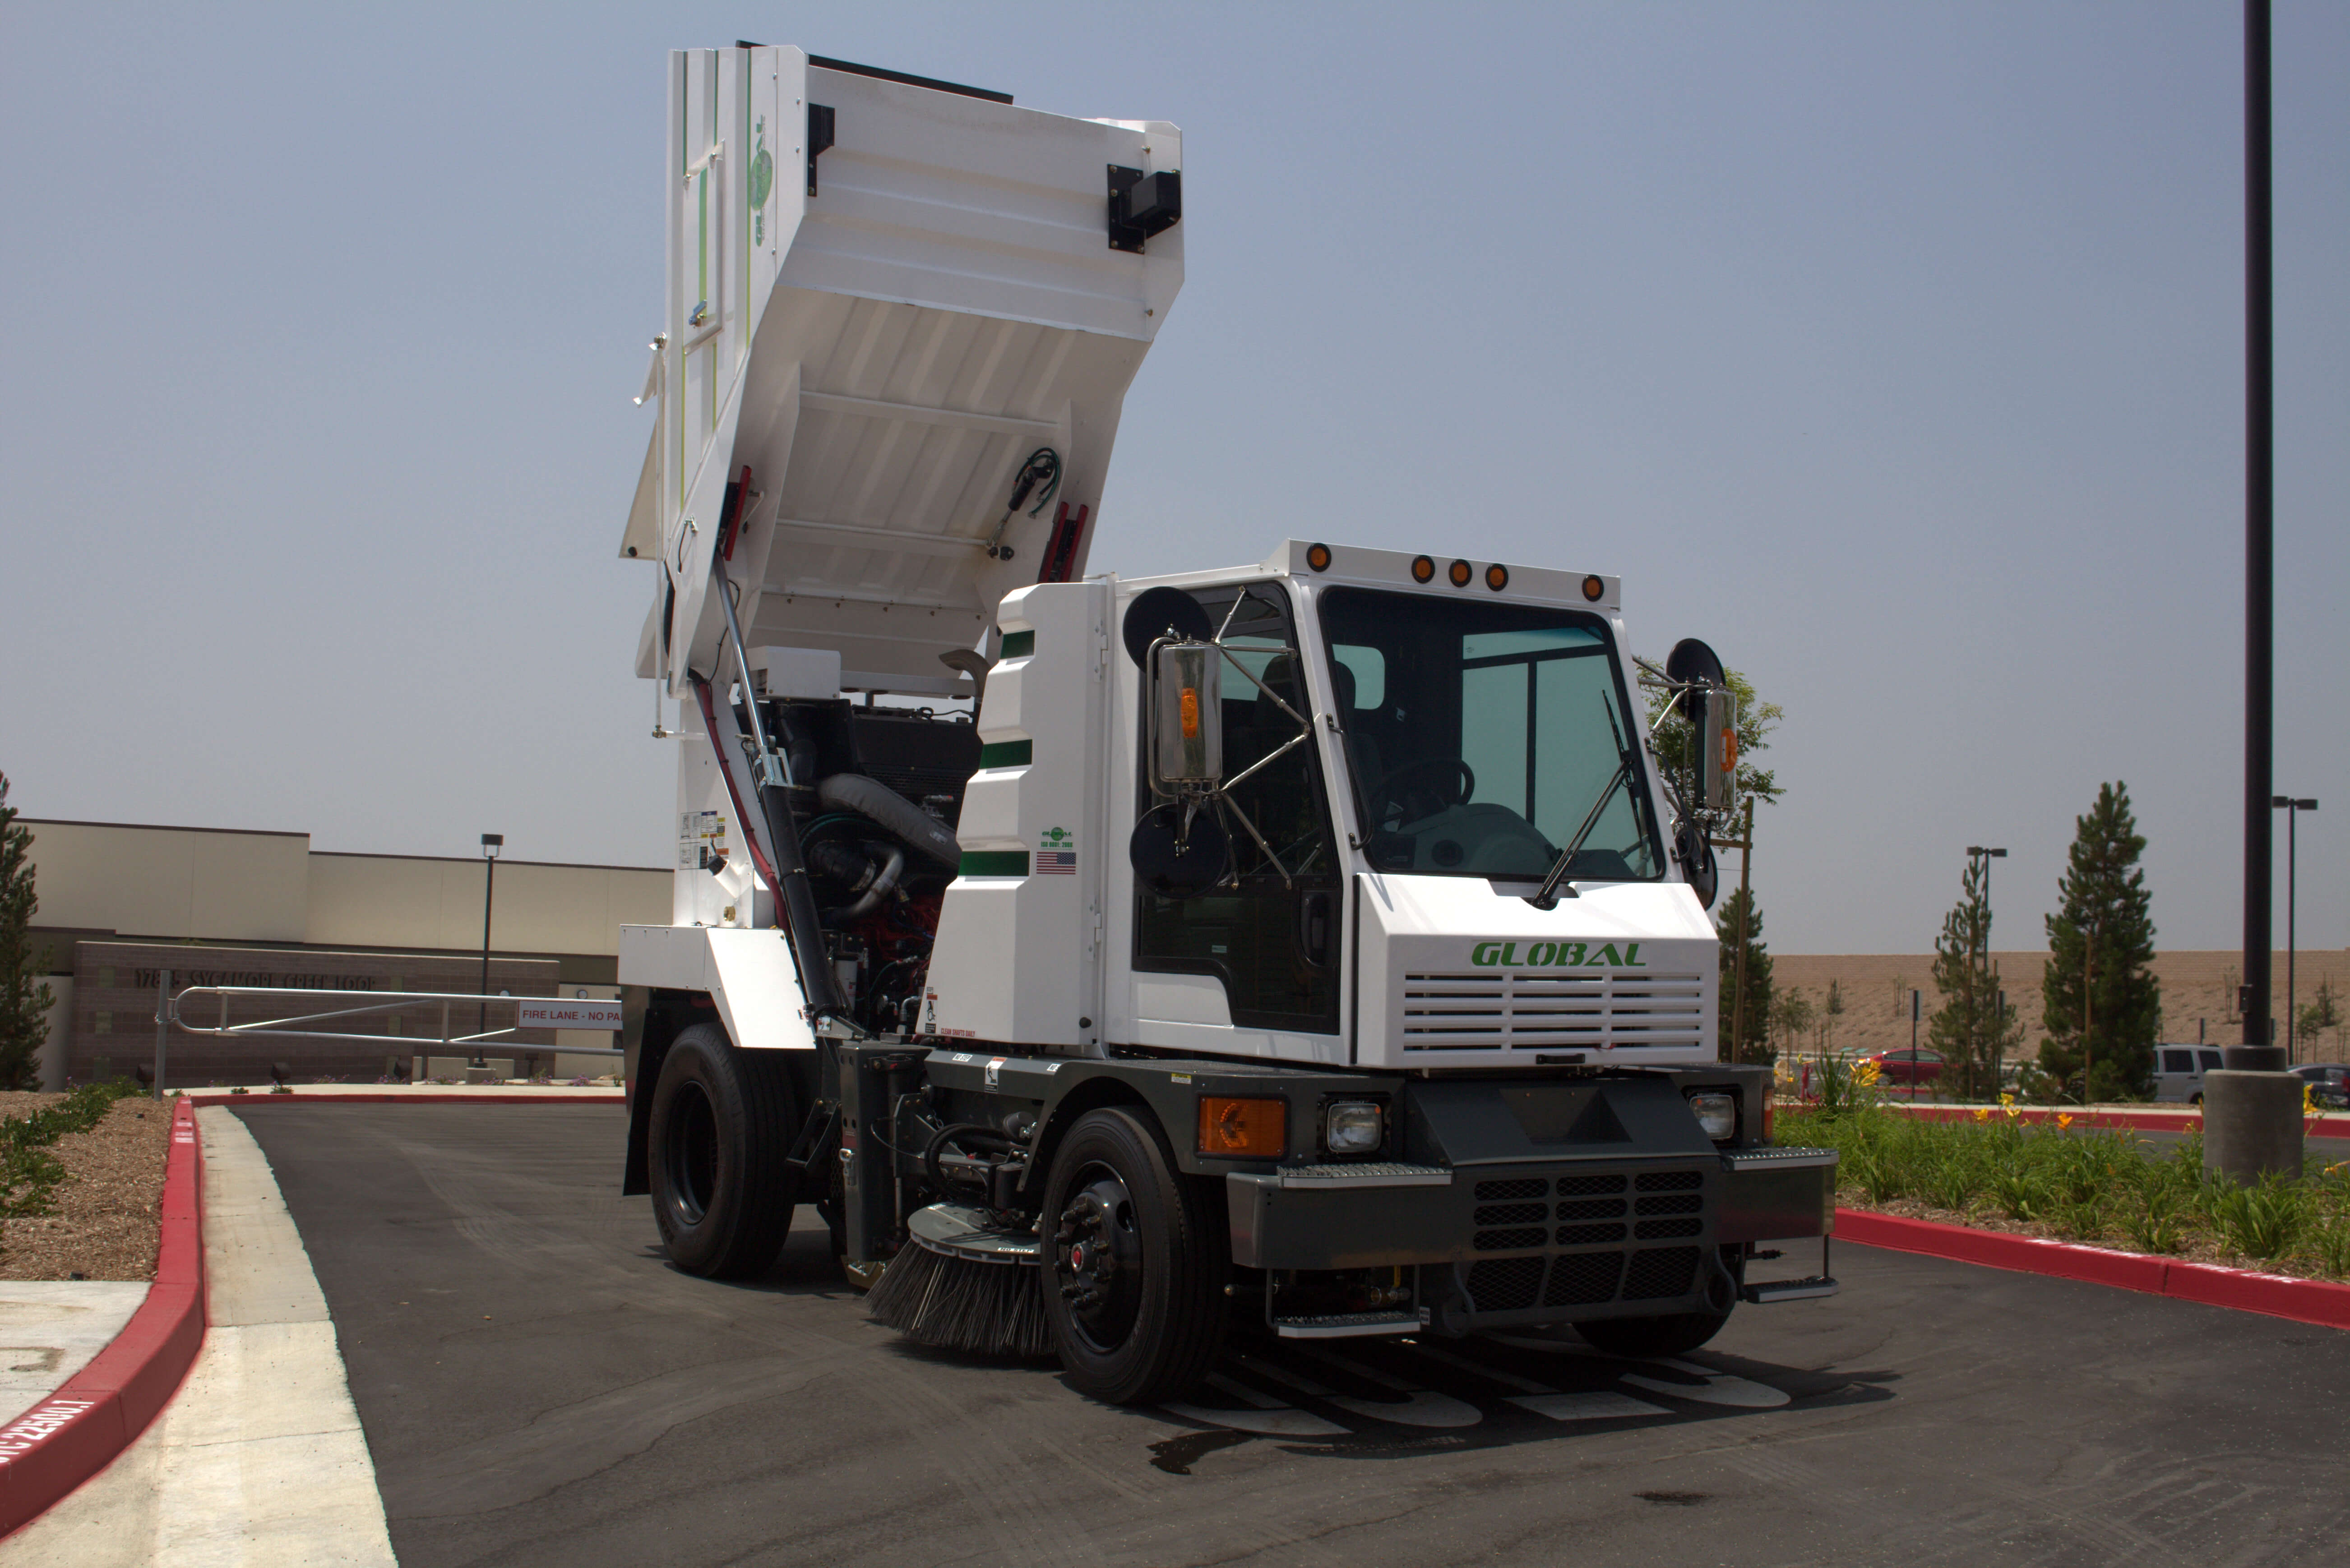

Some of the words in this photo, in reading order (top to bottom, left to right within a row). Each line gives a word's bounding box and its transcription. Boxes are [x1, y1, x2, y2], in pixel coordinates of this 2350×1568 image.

[1471, 942, 1647, 966] GLOBAL
[523, 1010, 547, 1019] FIRE
[550, 1010, 578, 1020] LANE
[588, 1012, 604, 1020] NO
[607, 1012, 622, 1021] PA
[0, 1400, 95, 1440] 22500.1
